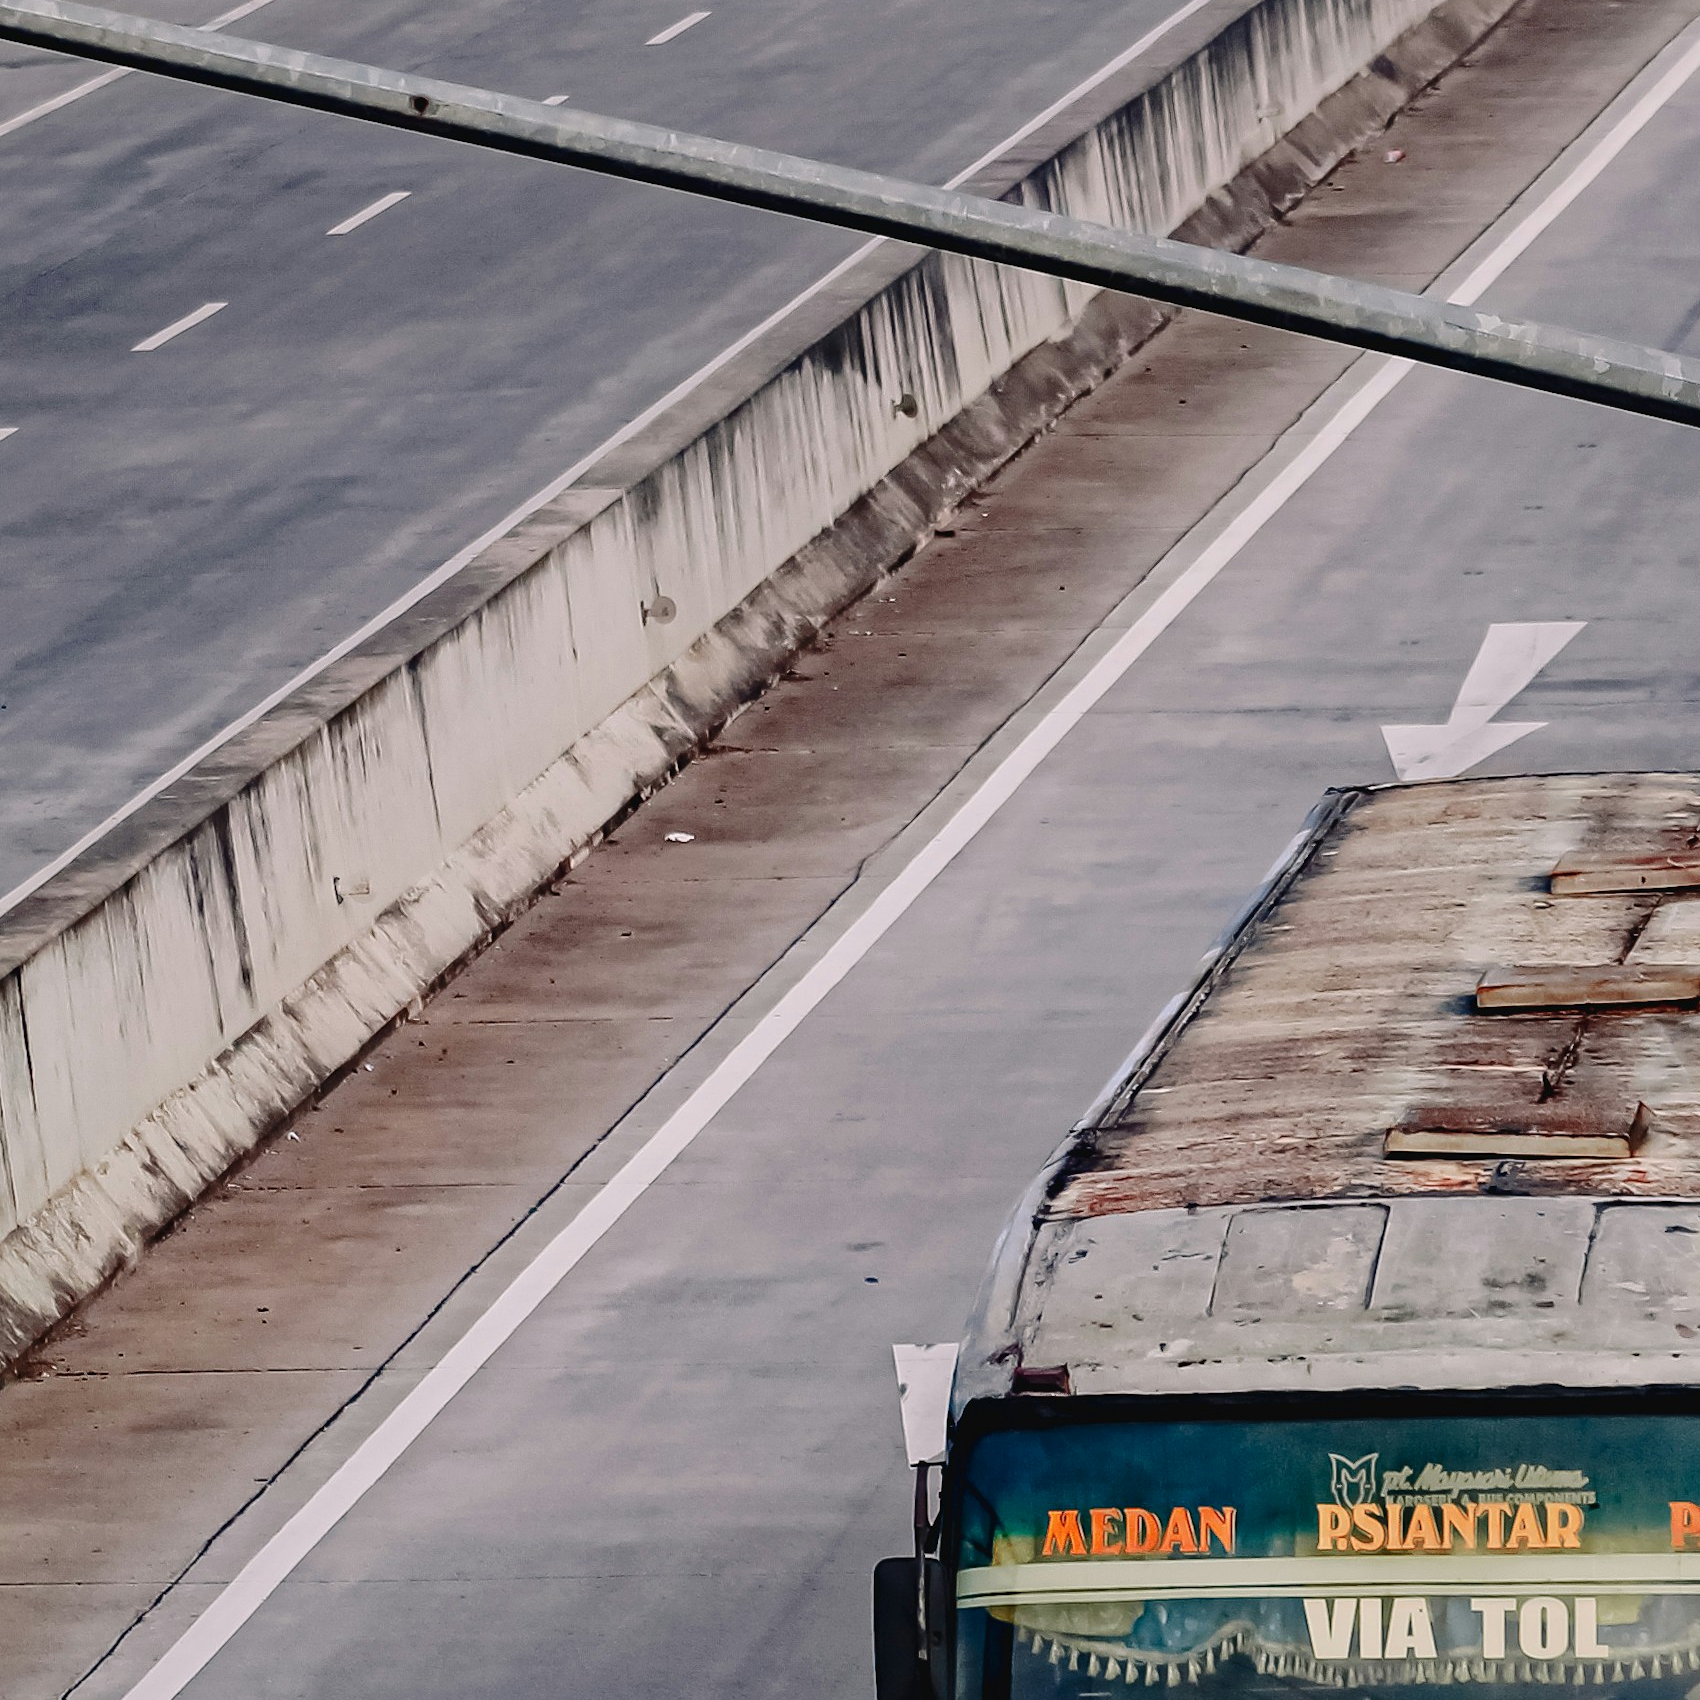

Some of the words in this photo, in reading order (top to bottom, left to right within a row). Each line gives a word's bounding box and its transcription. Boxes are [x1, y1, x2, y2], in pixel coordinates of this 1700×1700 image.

[1042, 1506, 1236, 1556] MEDAN
[1316, 1502, 1585, 1552] P.SIANTAR
[1304, 1598, 1438, 1660] VIA
[1471, 1597, 1609, 1660] TOL
